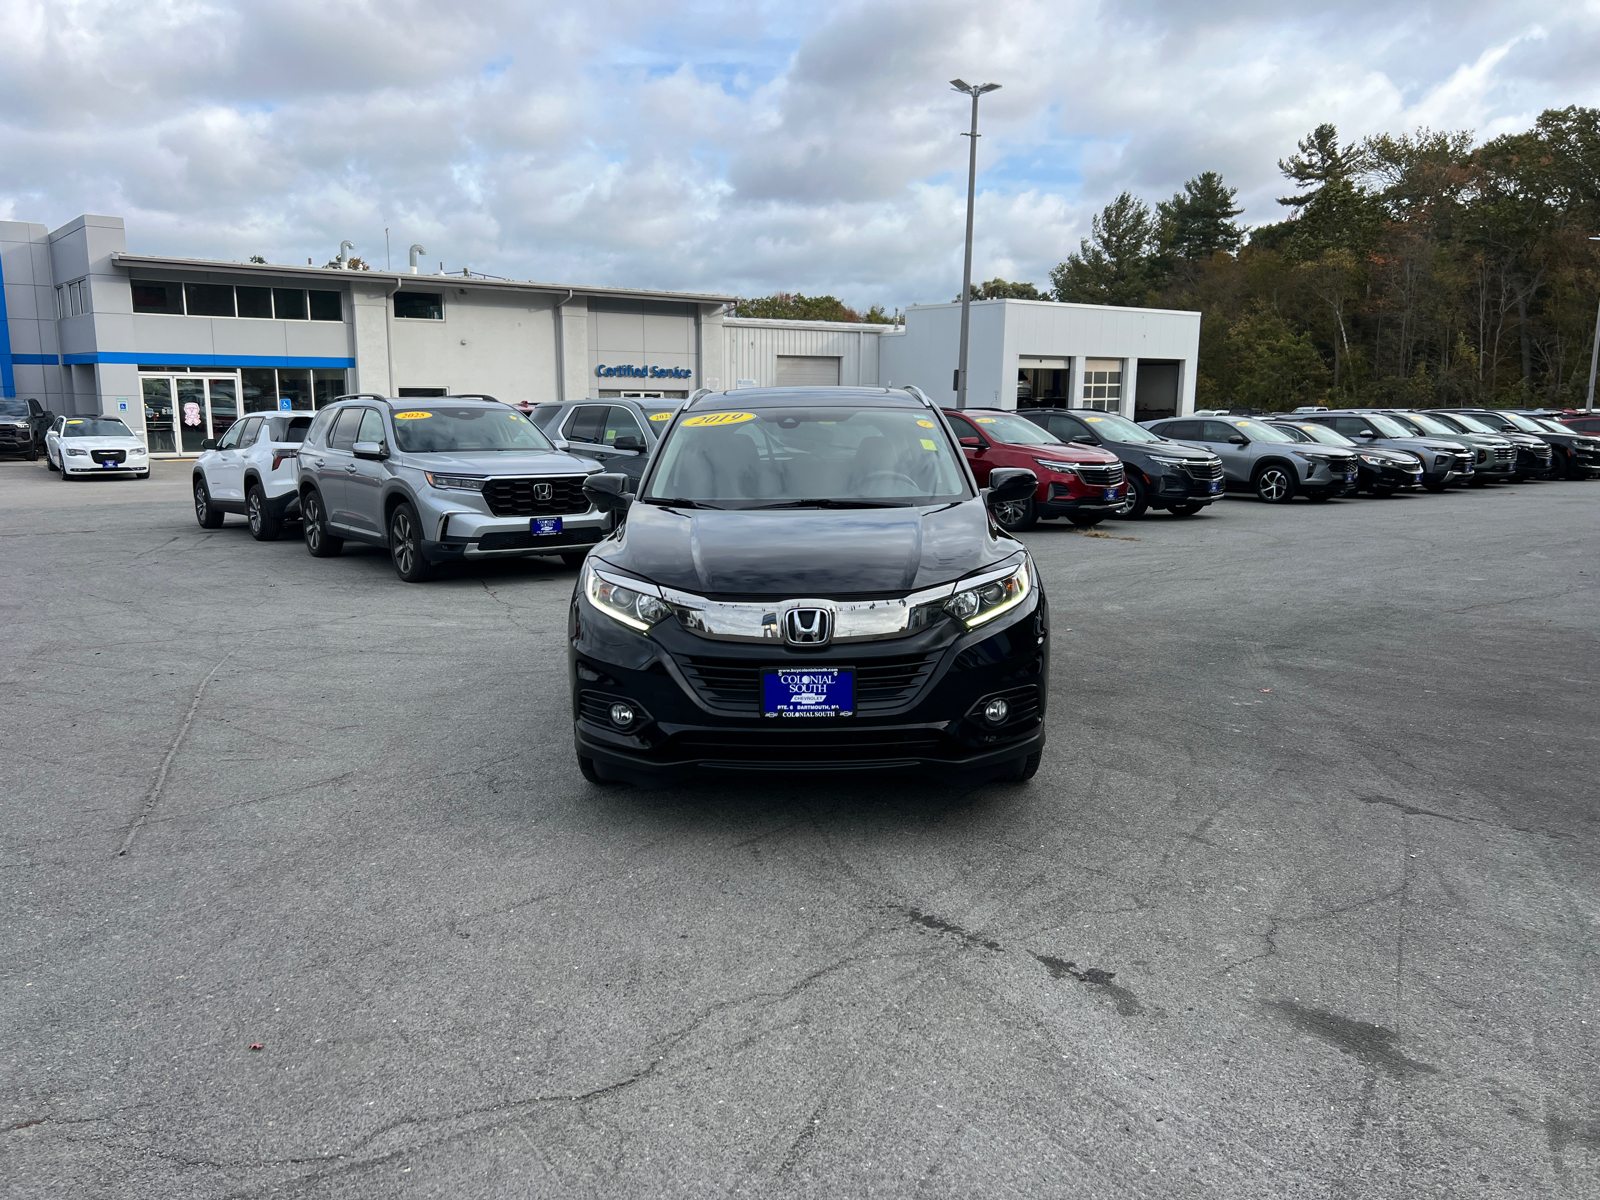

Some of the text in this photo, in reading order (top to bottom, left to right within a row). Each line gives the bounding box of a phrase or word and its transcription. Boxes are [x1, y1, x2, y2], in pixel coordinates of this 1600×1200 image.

[597, 364, 692, 378] Certified Service
[655, 412, 672, 421] 202
[692, 413, 744, 425] 2019
[781, 675, 836, 684] COLONIAL
[789, 684, 827, 693] SOUTH
